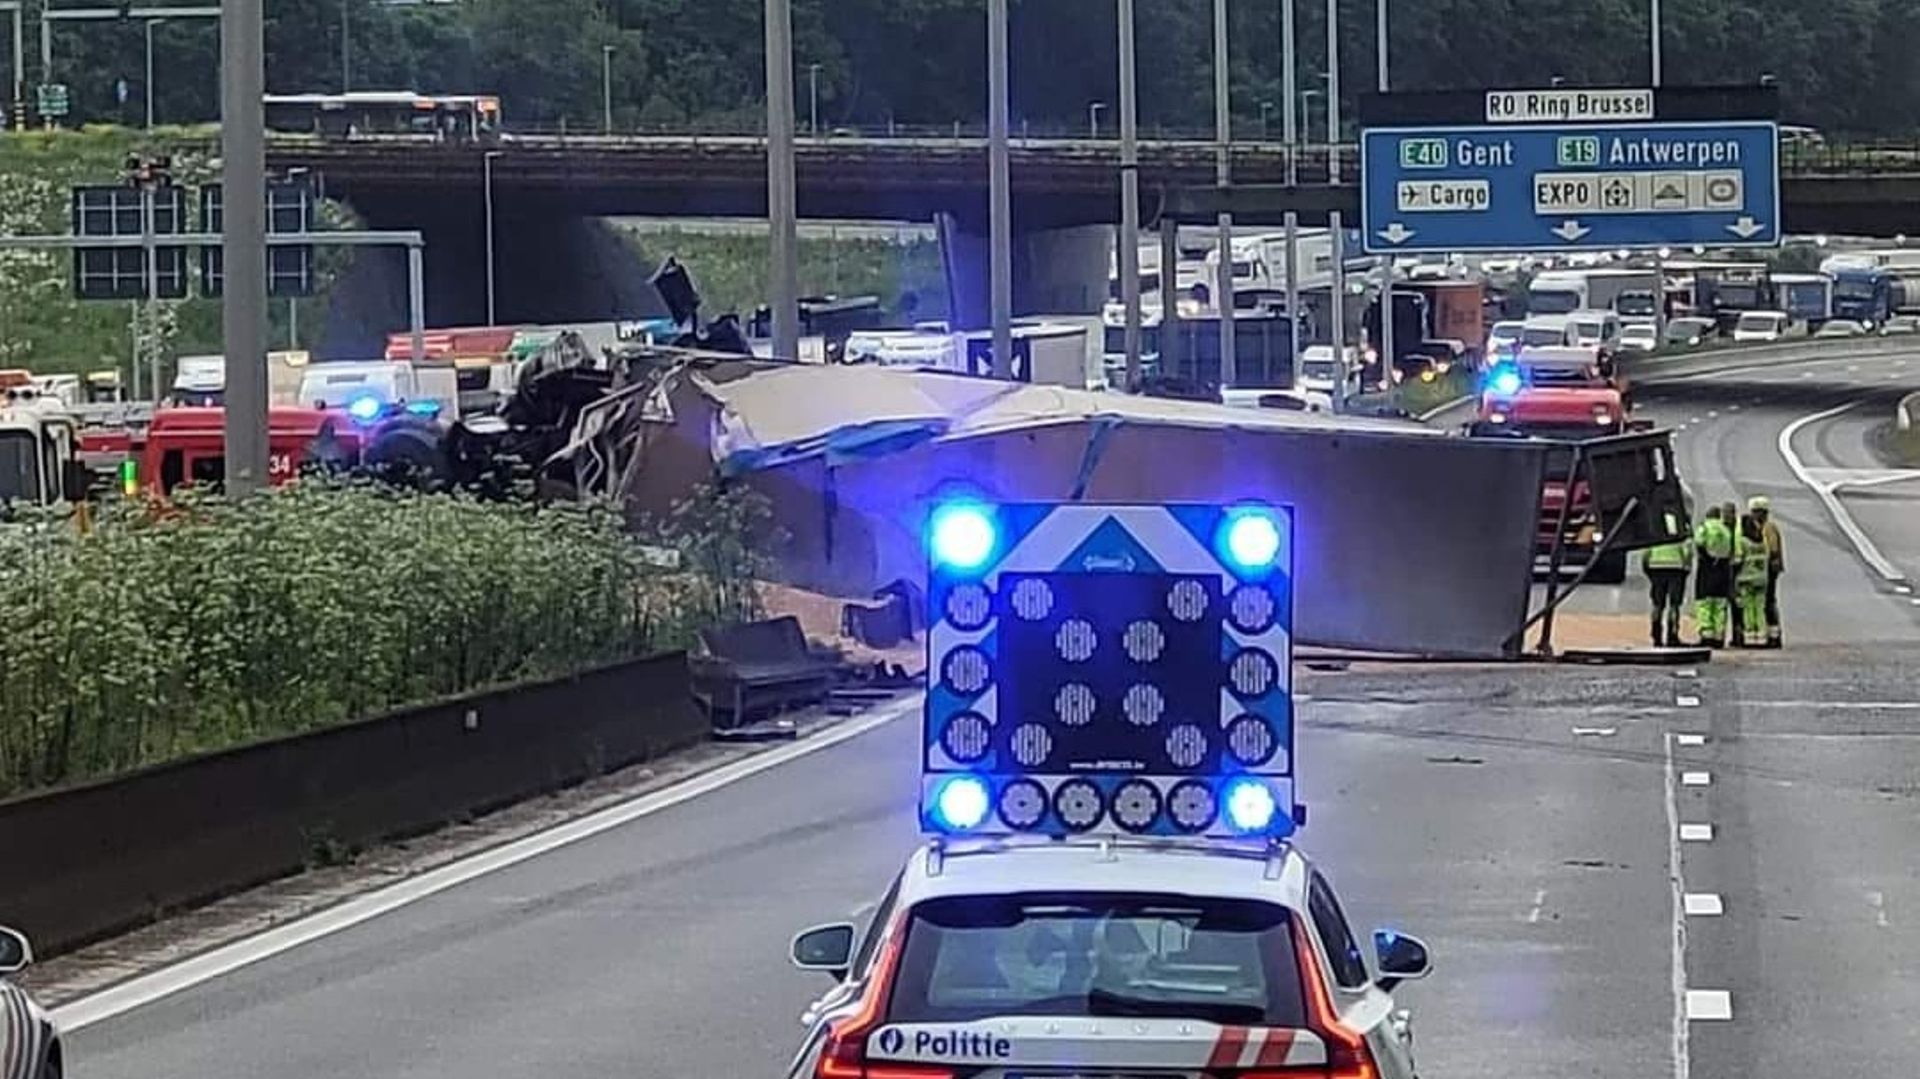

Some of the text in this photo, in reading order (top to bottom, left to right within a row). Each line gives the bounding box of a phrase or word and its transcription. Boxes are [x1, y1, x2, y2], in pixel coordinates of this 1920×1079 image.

[1527, 94, 1570, 119] Ring
[1577, 93, 1651, 114] Brussel
[1405, 140, 1514, 166] E40 Gent
[1561, 137, 1740, 168] E19 Antwerpen
[1430, 184, 1488, 208] Cargo
[1537, 182, 1589, 205] EXPO
[915, 1029, 1011, 1058] Politie
